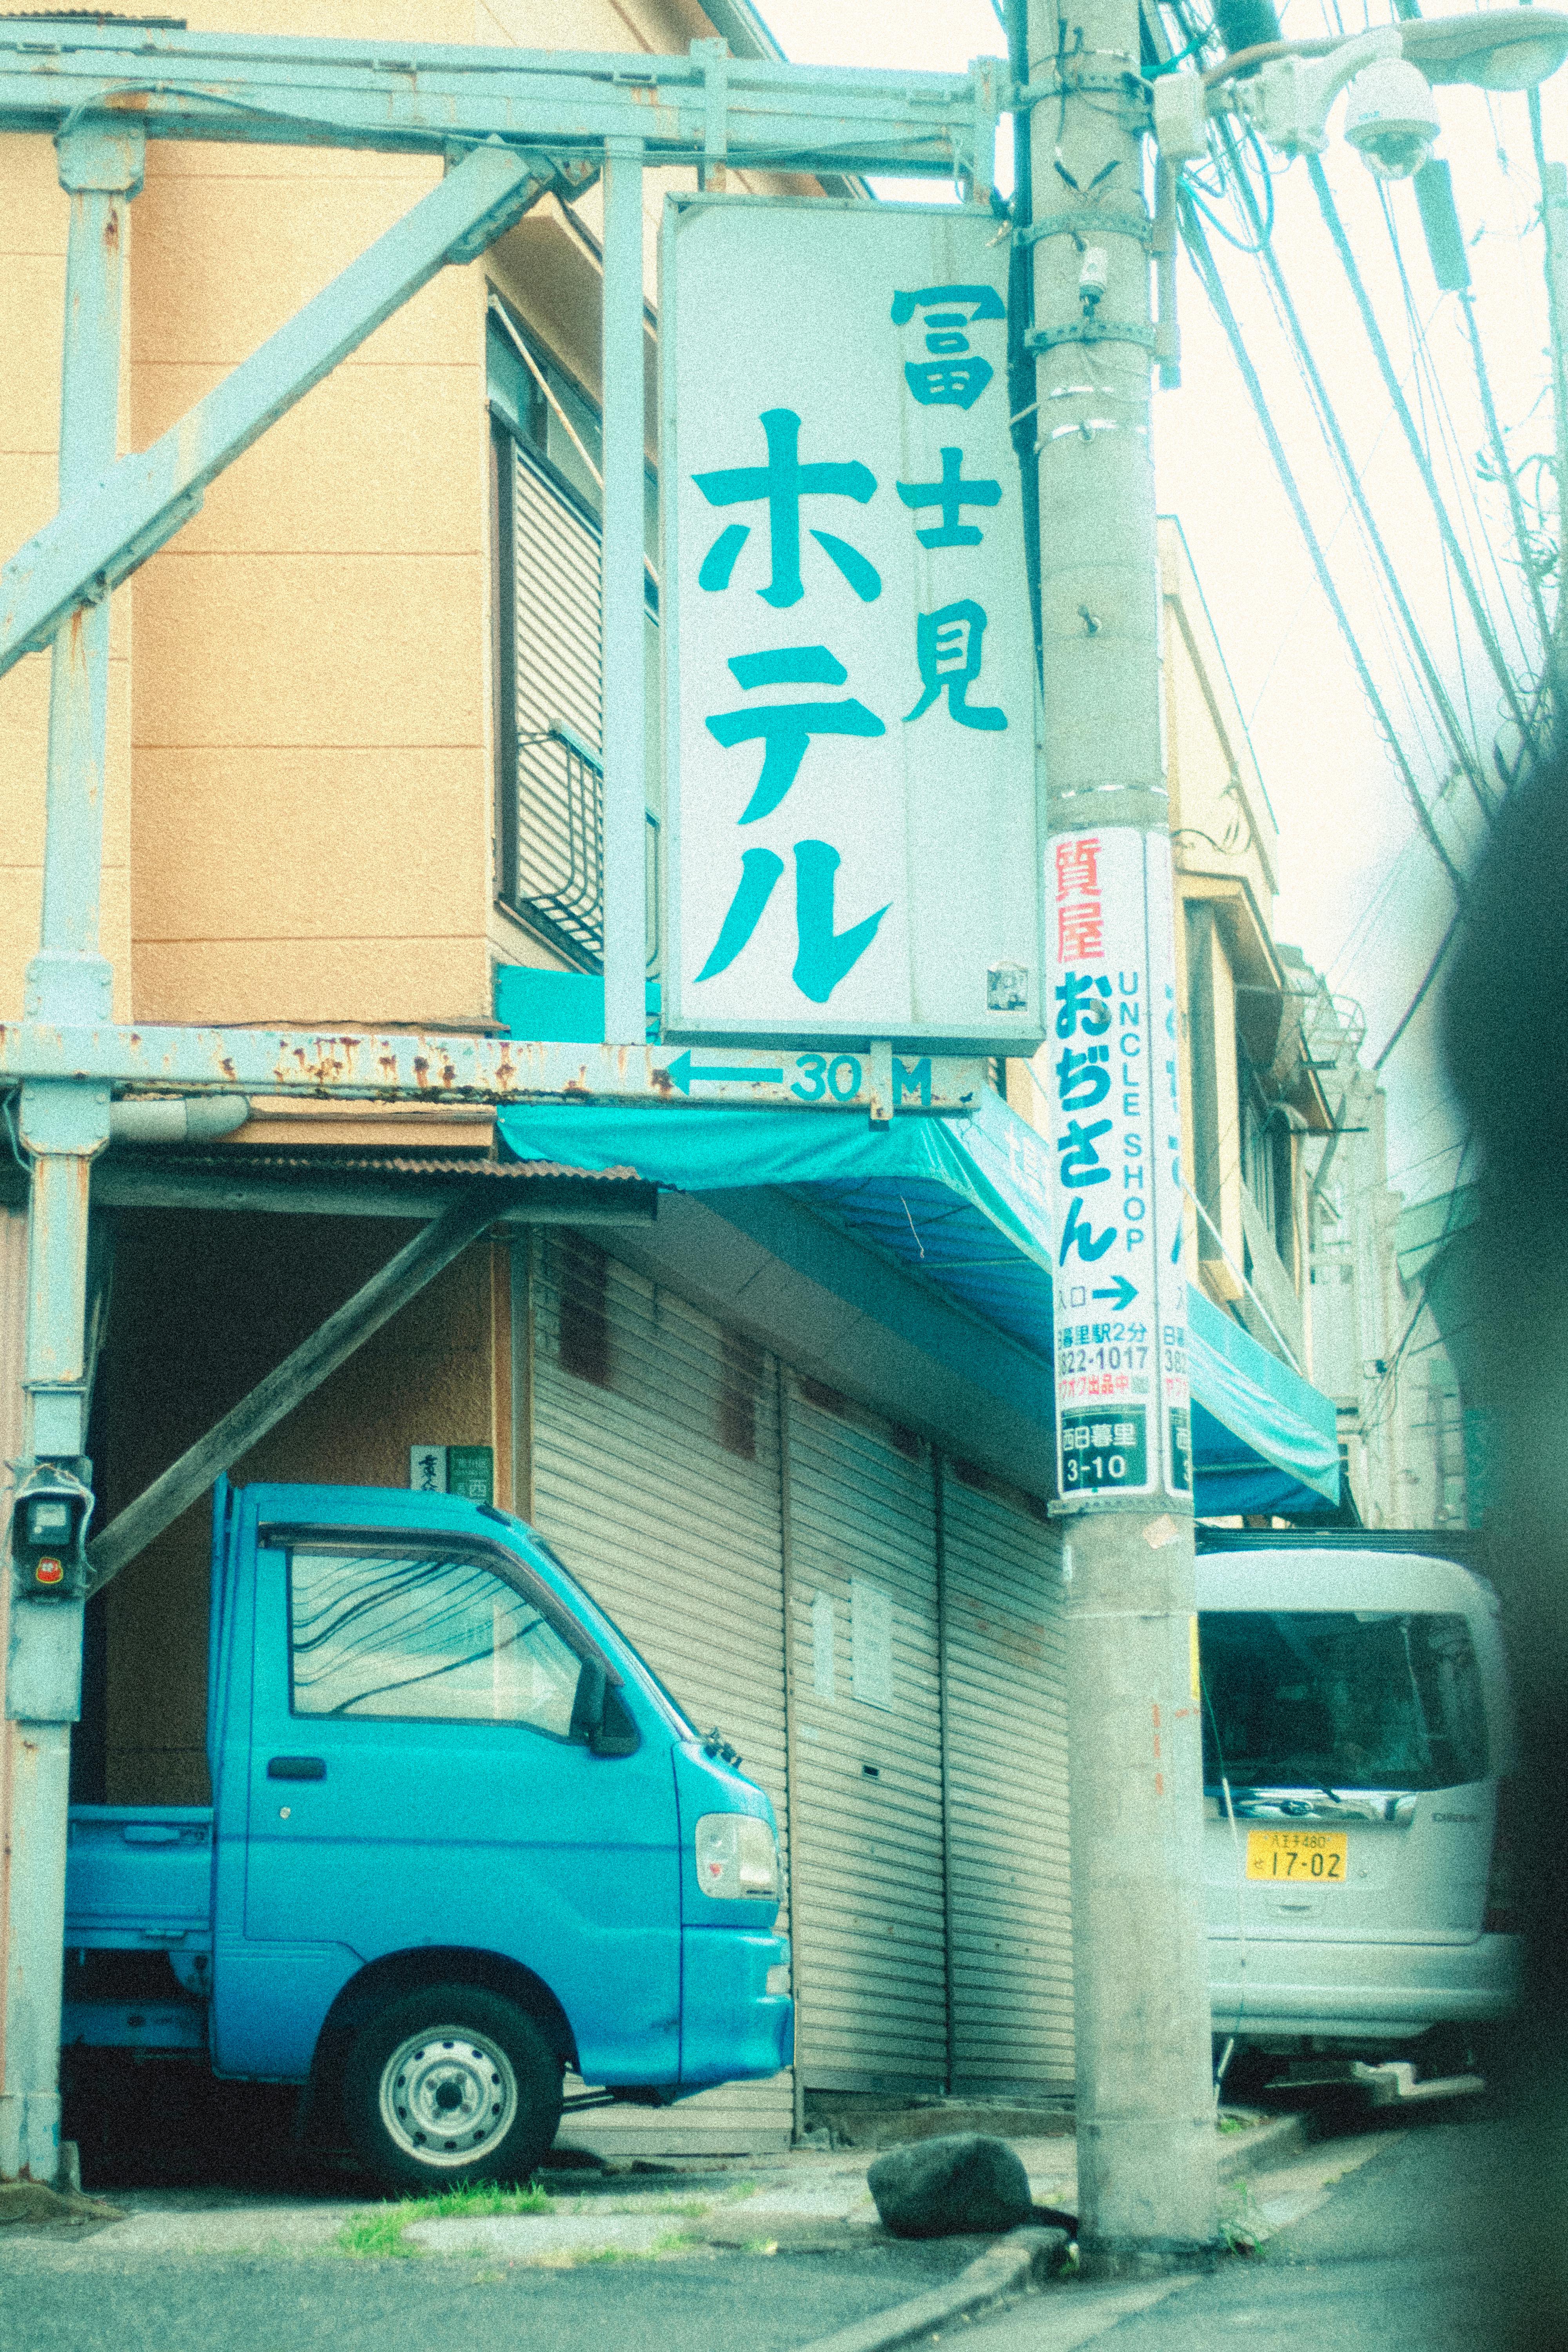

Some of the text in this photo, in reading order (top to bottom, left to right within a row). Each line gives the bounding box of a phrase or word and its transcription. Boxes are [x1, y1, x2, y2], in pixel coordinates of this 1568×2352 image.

[691, 408, 893, 1003] ホテル
[1055, 837, 1105, 963] 質屋
[1055, 971, 1118, 1267] おぢさん
[1119, 971, 1146, 1252] UNCLE SHOP
[1063, 1423, 1136, 1451] 西日暮里
[1067, 1455, 1126, 1482] 3-10
[1272, 1851, 1341, 1878] 17-02
